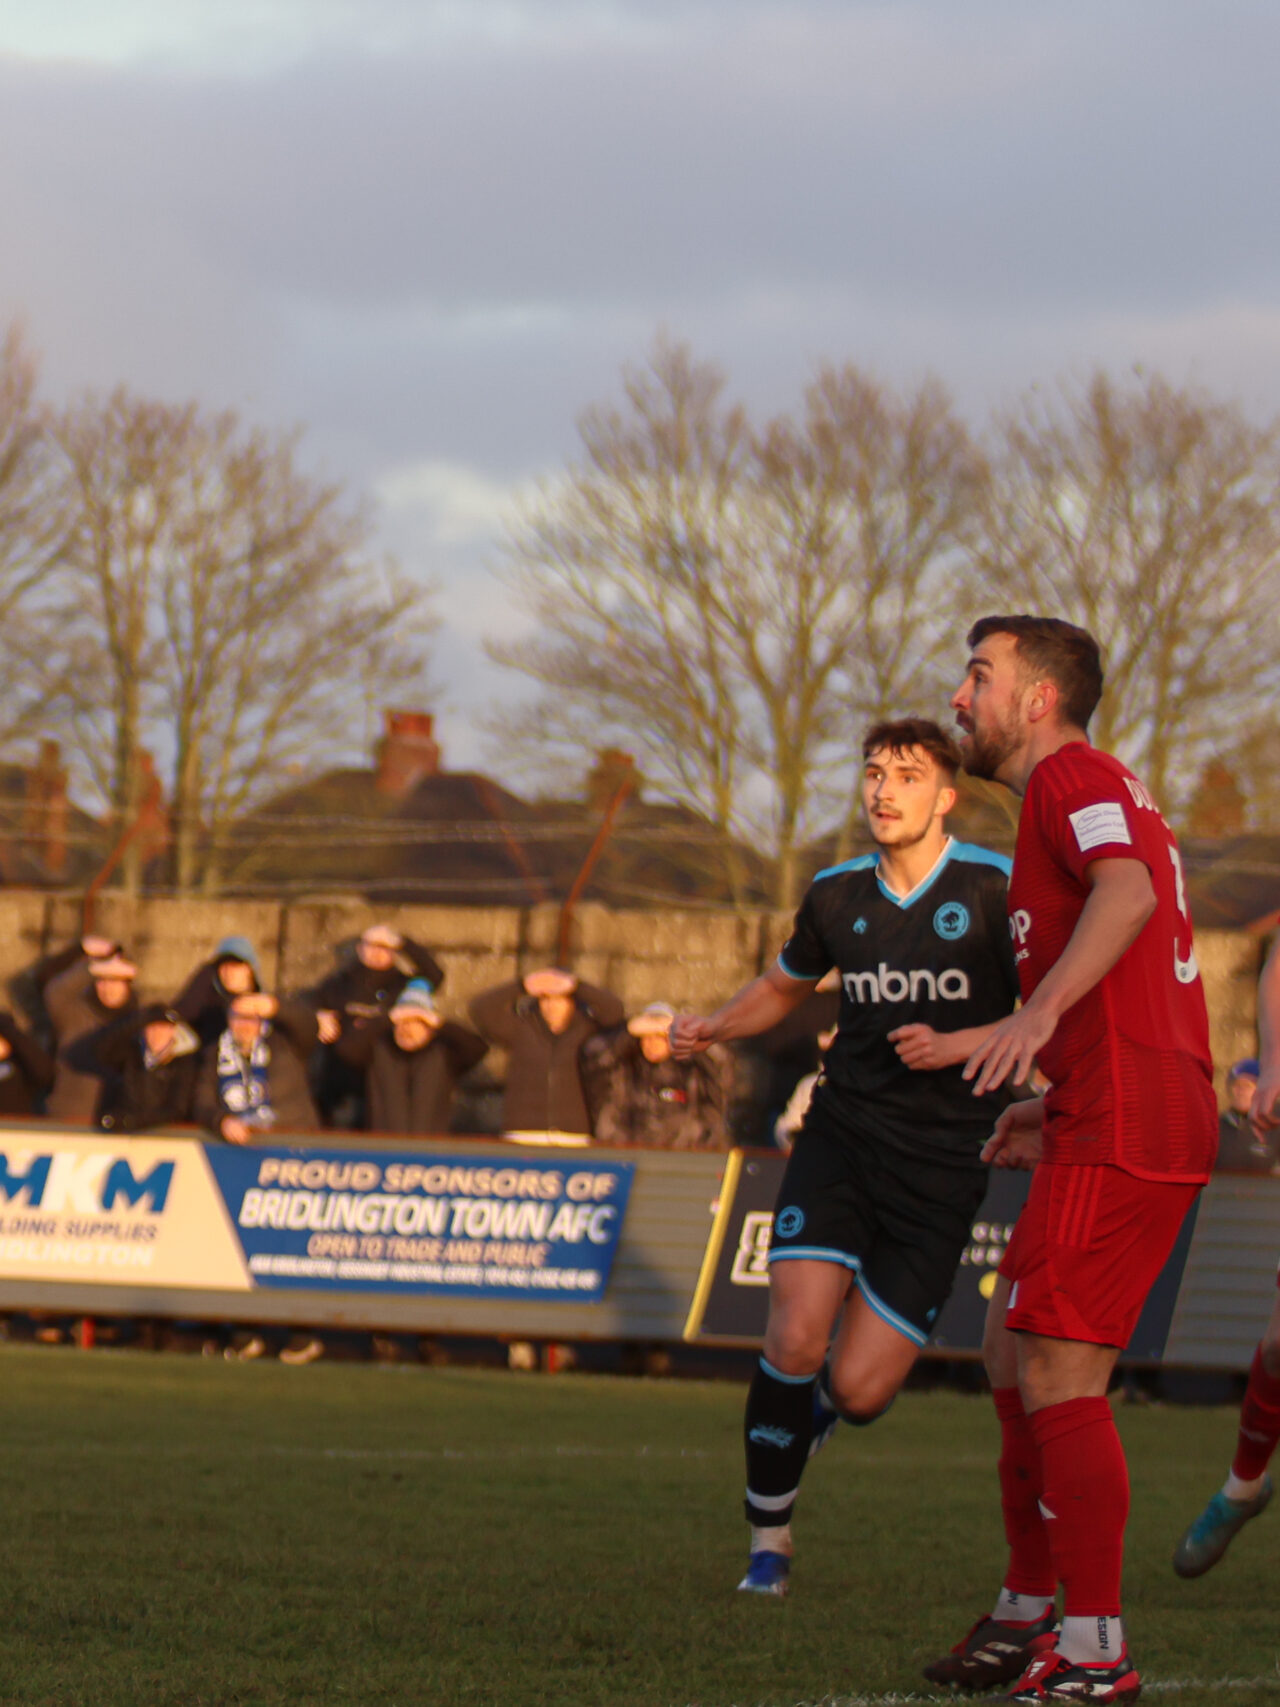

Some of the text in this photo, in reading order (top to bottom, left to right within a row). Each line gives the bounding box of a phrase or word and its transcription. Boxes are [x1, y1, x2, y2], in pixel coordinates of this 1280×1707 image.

[842, 962, 970, 1003] mbna
[258, 1157, 617, 1201] PROUD SPONSORS OF
[64, 1222, 157, 1241] SUPPLIES
[238, 1187, 616, 1244] BRIDLINGTON TOWN AFC
